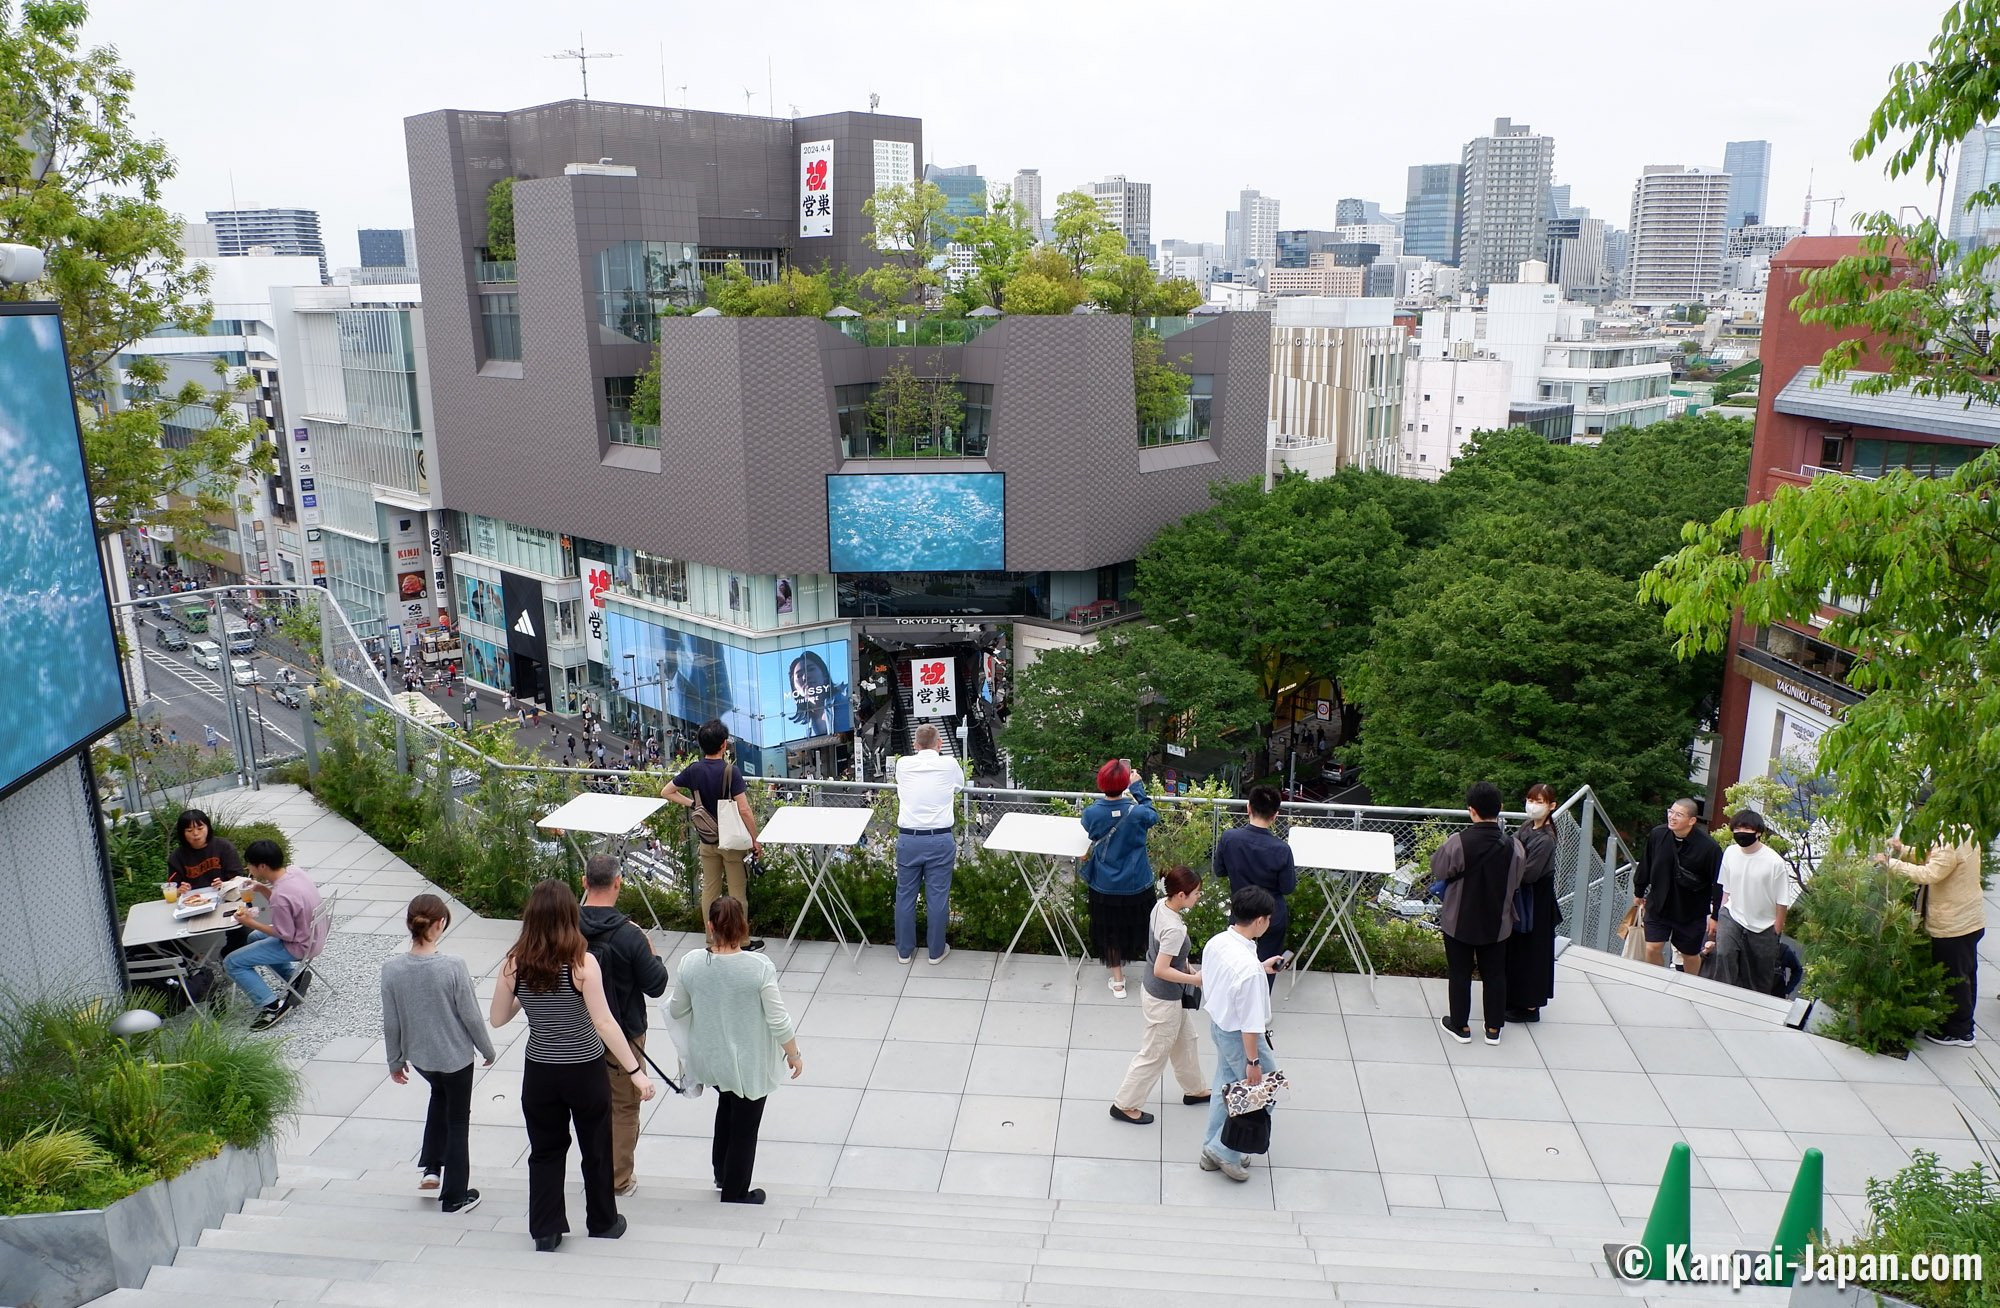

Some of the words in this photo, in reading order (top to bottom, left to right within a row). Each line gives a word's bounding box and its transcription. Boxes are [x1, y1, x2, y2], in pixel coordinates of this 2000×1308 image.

[803, 144, 831, 155] 2024.4.4
[802, 194, 831, 218] 営巣
[397, 547, 420, 560] KINJI
[931, 617, 965, 625] PLAZA
[783, 684, 830, 699] MOUSSY
[917, 686, 952, 704] 営巣
[1776, 678, 1810, 703] YAKINIKU
[1810, 695, 1832, 717] dining
